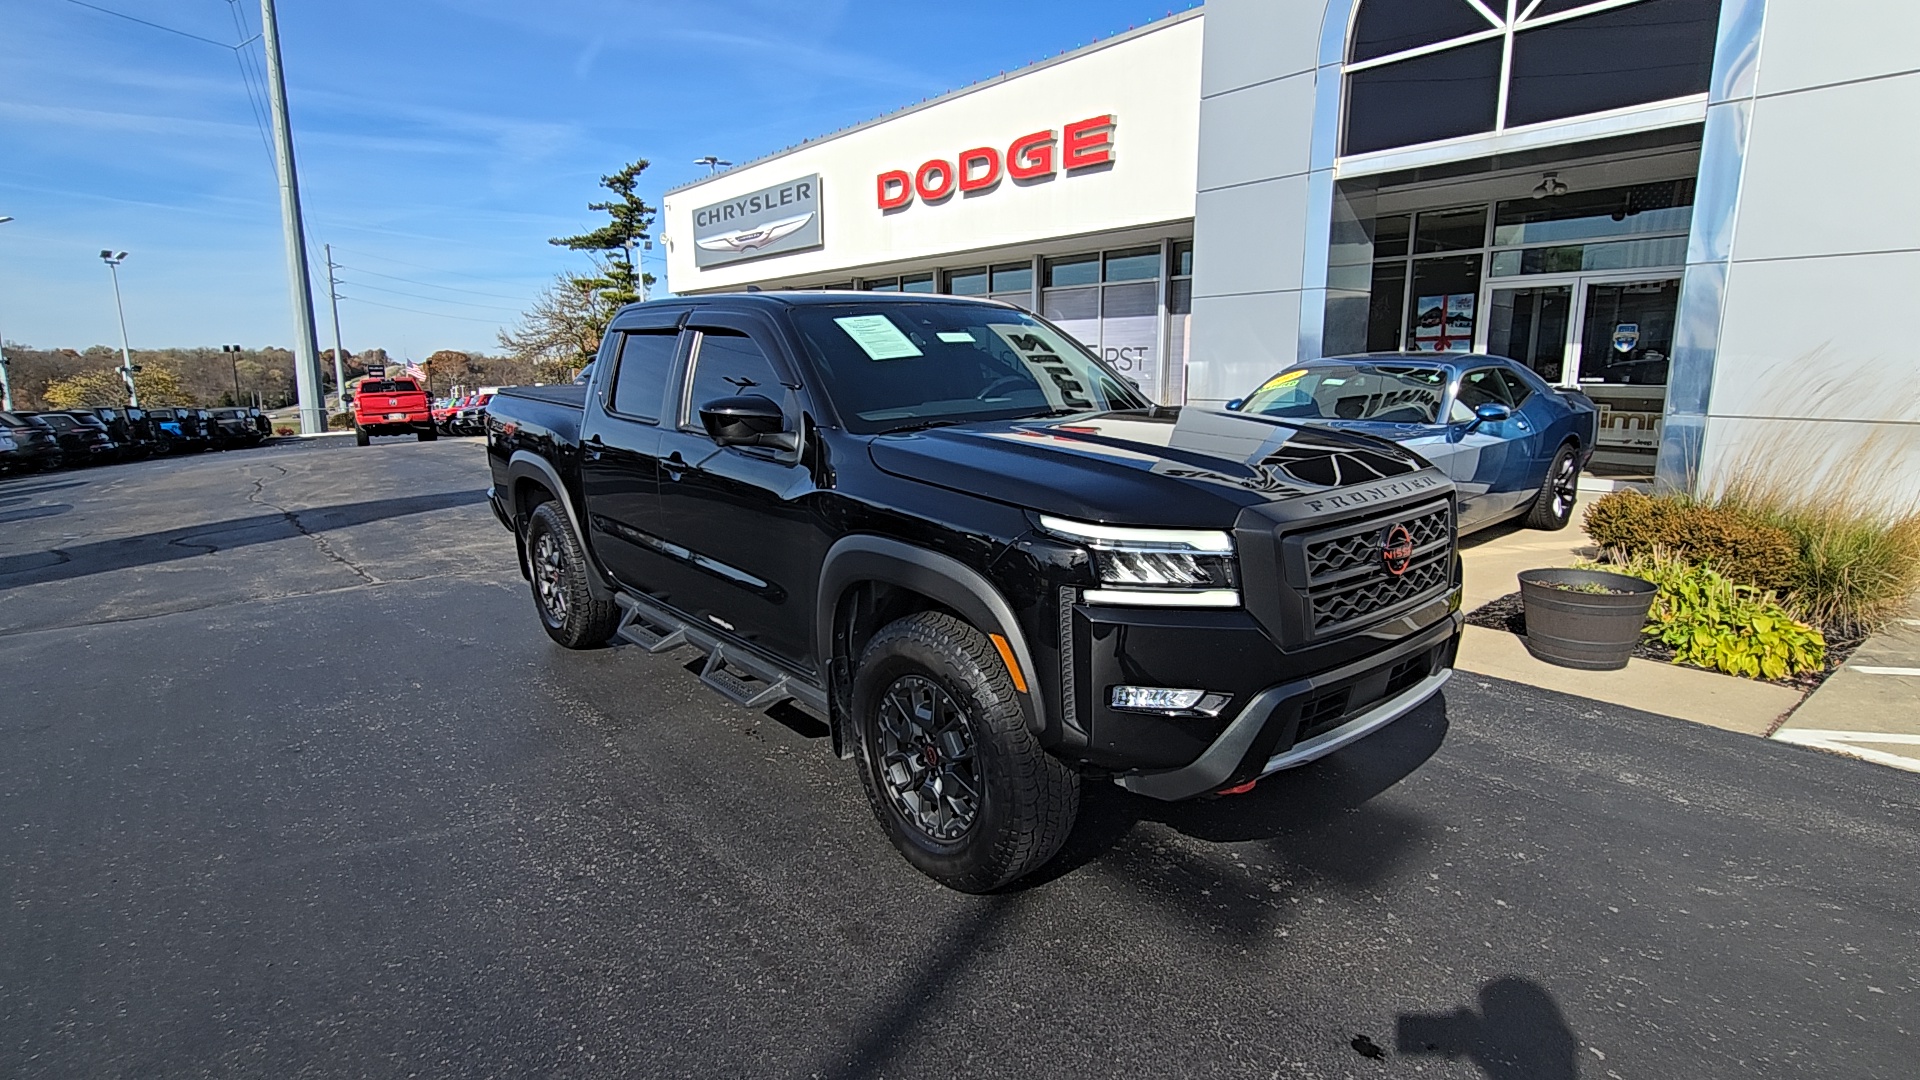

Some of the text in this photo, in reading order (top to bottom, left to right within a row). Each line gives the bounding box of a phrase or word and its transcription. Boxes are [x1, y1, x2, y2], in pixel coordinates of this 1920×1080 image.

[877, 114, 1115, 210] DODGE
[696, 183, 811, 227] CHRYSLER
[1304, 476, 1437, 513] FRONTIER
